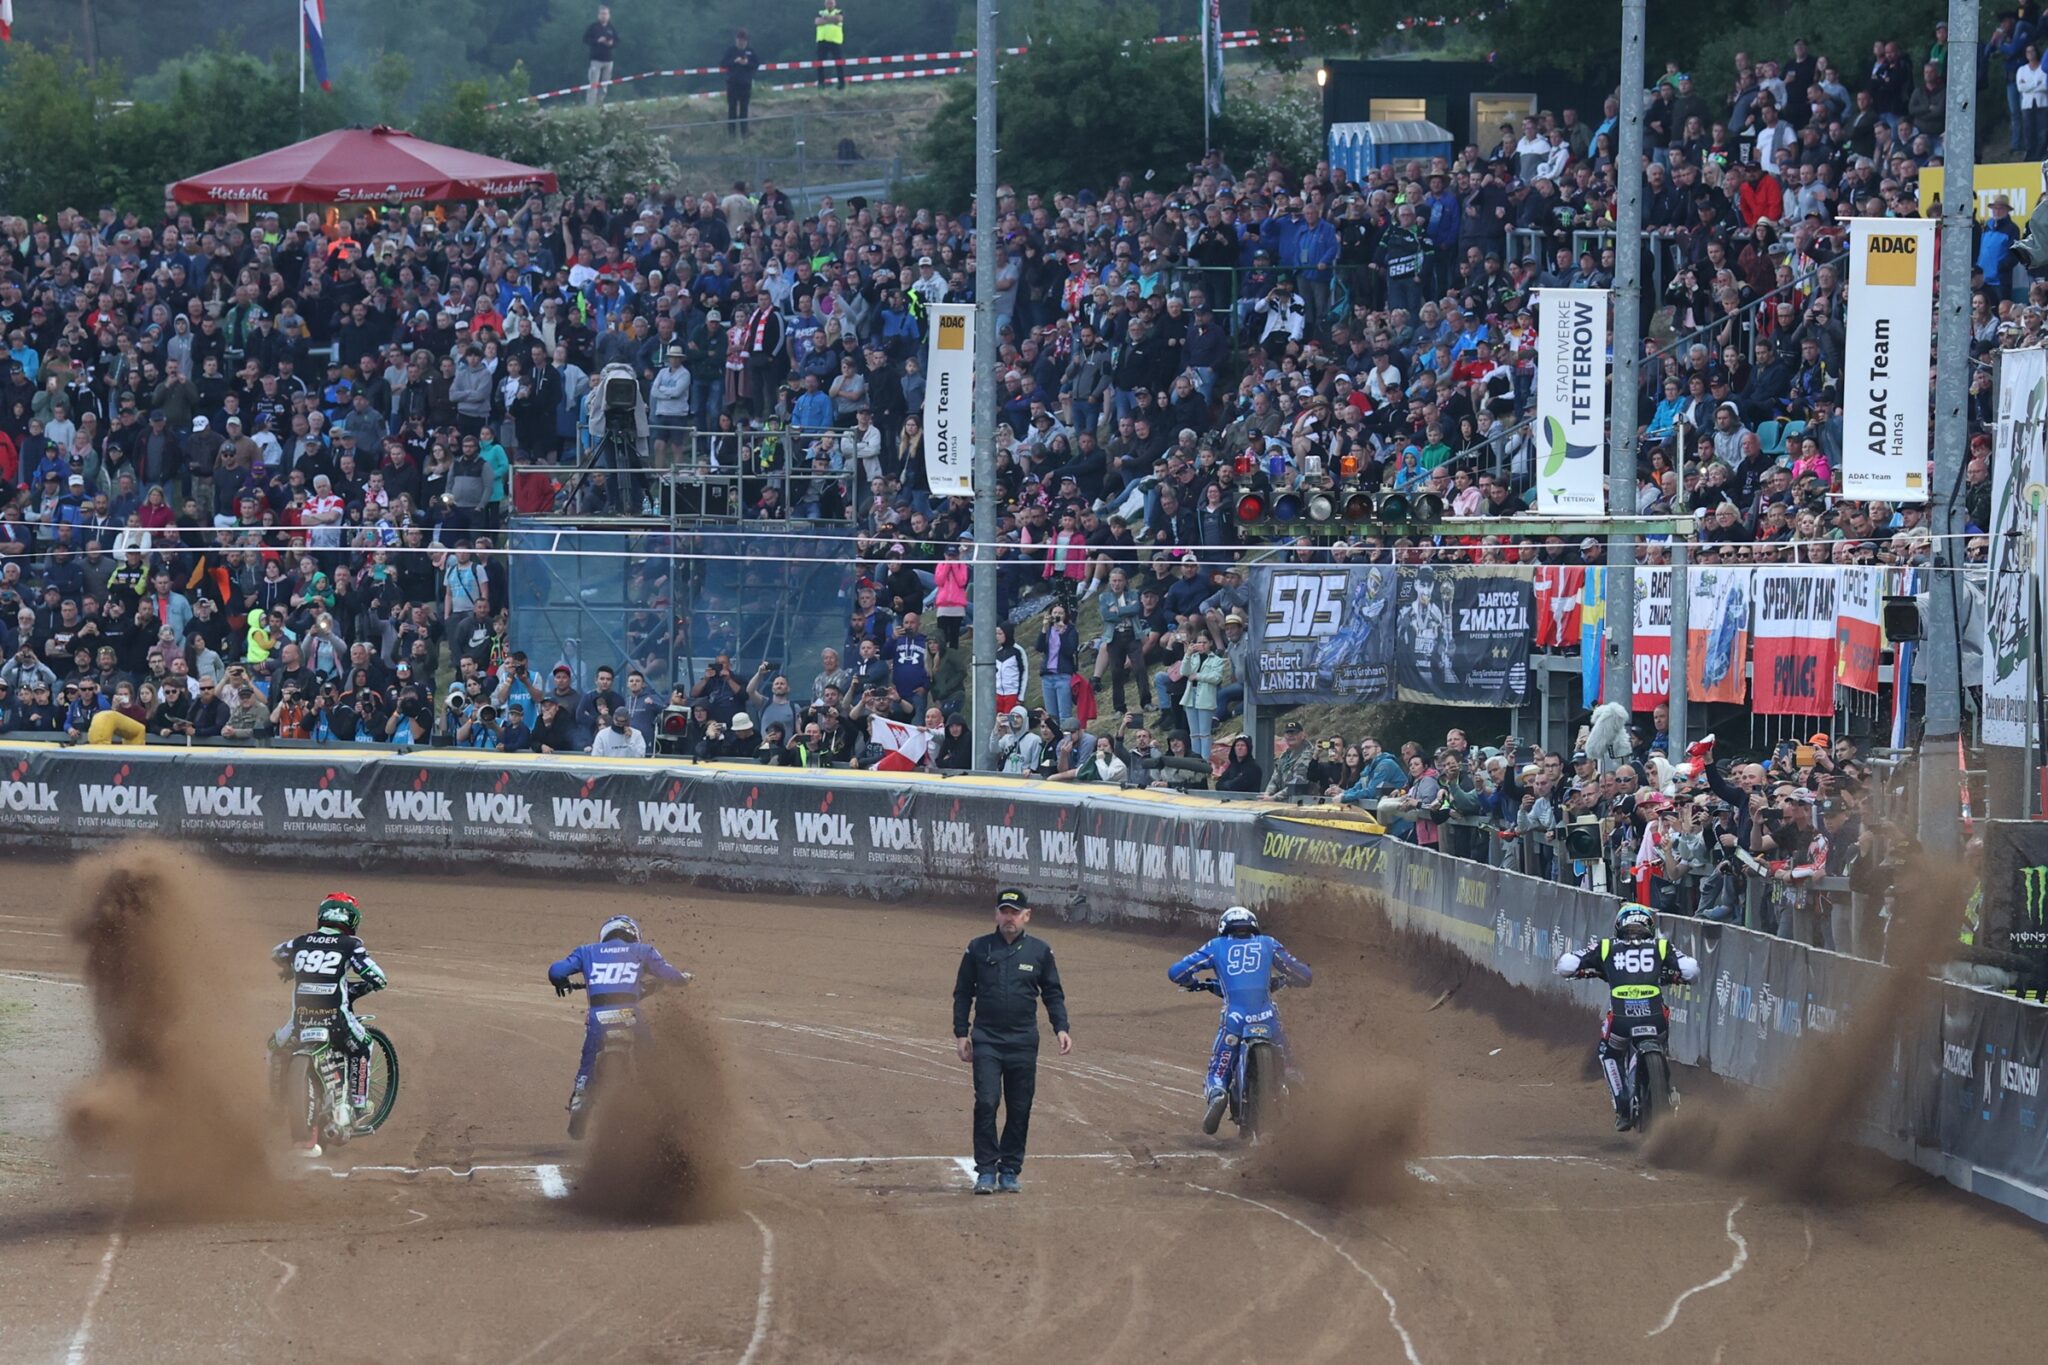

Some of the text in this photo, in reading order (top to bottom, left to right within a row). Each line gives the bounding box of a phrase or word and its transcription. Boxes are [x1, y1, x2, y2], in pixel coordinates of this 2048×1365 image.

[208, 187, 269, 200] Holzkohle
[334, 187, 426, 202] Schwengrill
[482, 181, 530, 195] Holzkohl
[1977, 188, 2027, 217] TEM
[1869, 237, 1916, 253] ADAC
[940, 317, 965, 329] ADAC
[1556, 300, 1571, 403] STADTWERKE
[1571, 301, 1594, 425] TETEROW
[1868, 318, 1891, 456] ADAC Team
[938, 372, 950, 465] ADAC Team
[1892, 413, 1905, 456] Hansa
[1651, 571, 1673, 599] BART
[1264, 573, 1347, 639] 505
[1478, 592, 1520, 608] BARTOS
[1762, 577, 1837, 621] SPEEDWAY FANS
[1260, 652, 1302, 672] Robert
[1260, 671, 1318, 691] LAMBERT
[77, 816, 99, 827] EVENT
[101, 818, 136, 828] HAMBURG
[181, 819, 204, 829] EVENT
[283, 821, 305, 831] EVENT
[306, 822, 342, 833] HAMBURG
[384, 824, 403, 834] EVENT
[464, 826, 483, 836] EVENT
[549, 831, 569, 841] EVENT
[718, 841, 735, 851] EVENT
[793, 847, 810, 857] EVENT
[810, 848, 839, 860] HAMBURG
[1305, 840, 1342, 865] MISS
[1339, 845, 1379, 873] ANY
[306, 935, 339, 944] DUDEK
[600, 946, 630, 954] LAMBERT
[294, 949, 342, 975] 692
[1227, 943, 1261, 976] 95
[1613, 948, 1655, 974] #66
[589, 962, 641, 985] 505
[1245, 1009, 1273, 1024] ORLEN
[1625, 1008, 1651, 1016] CARS
